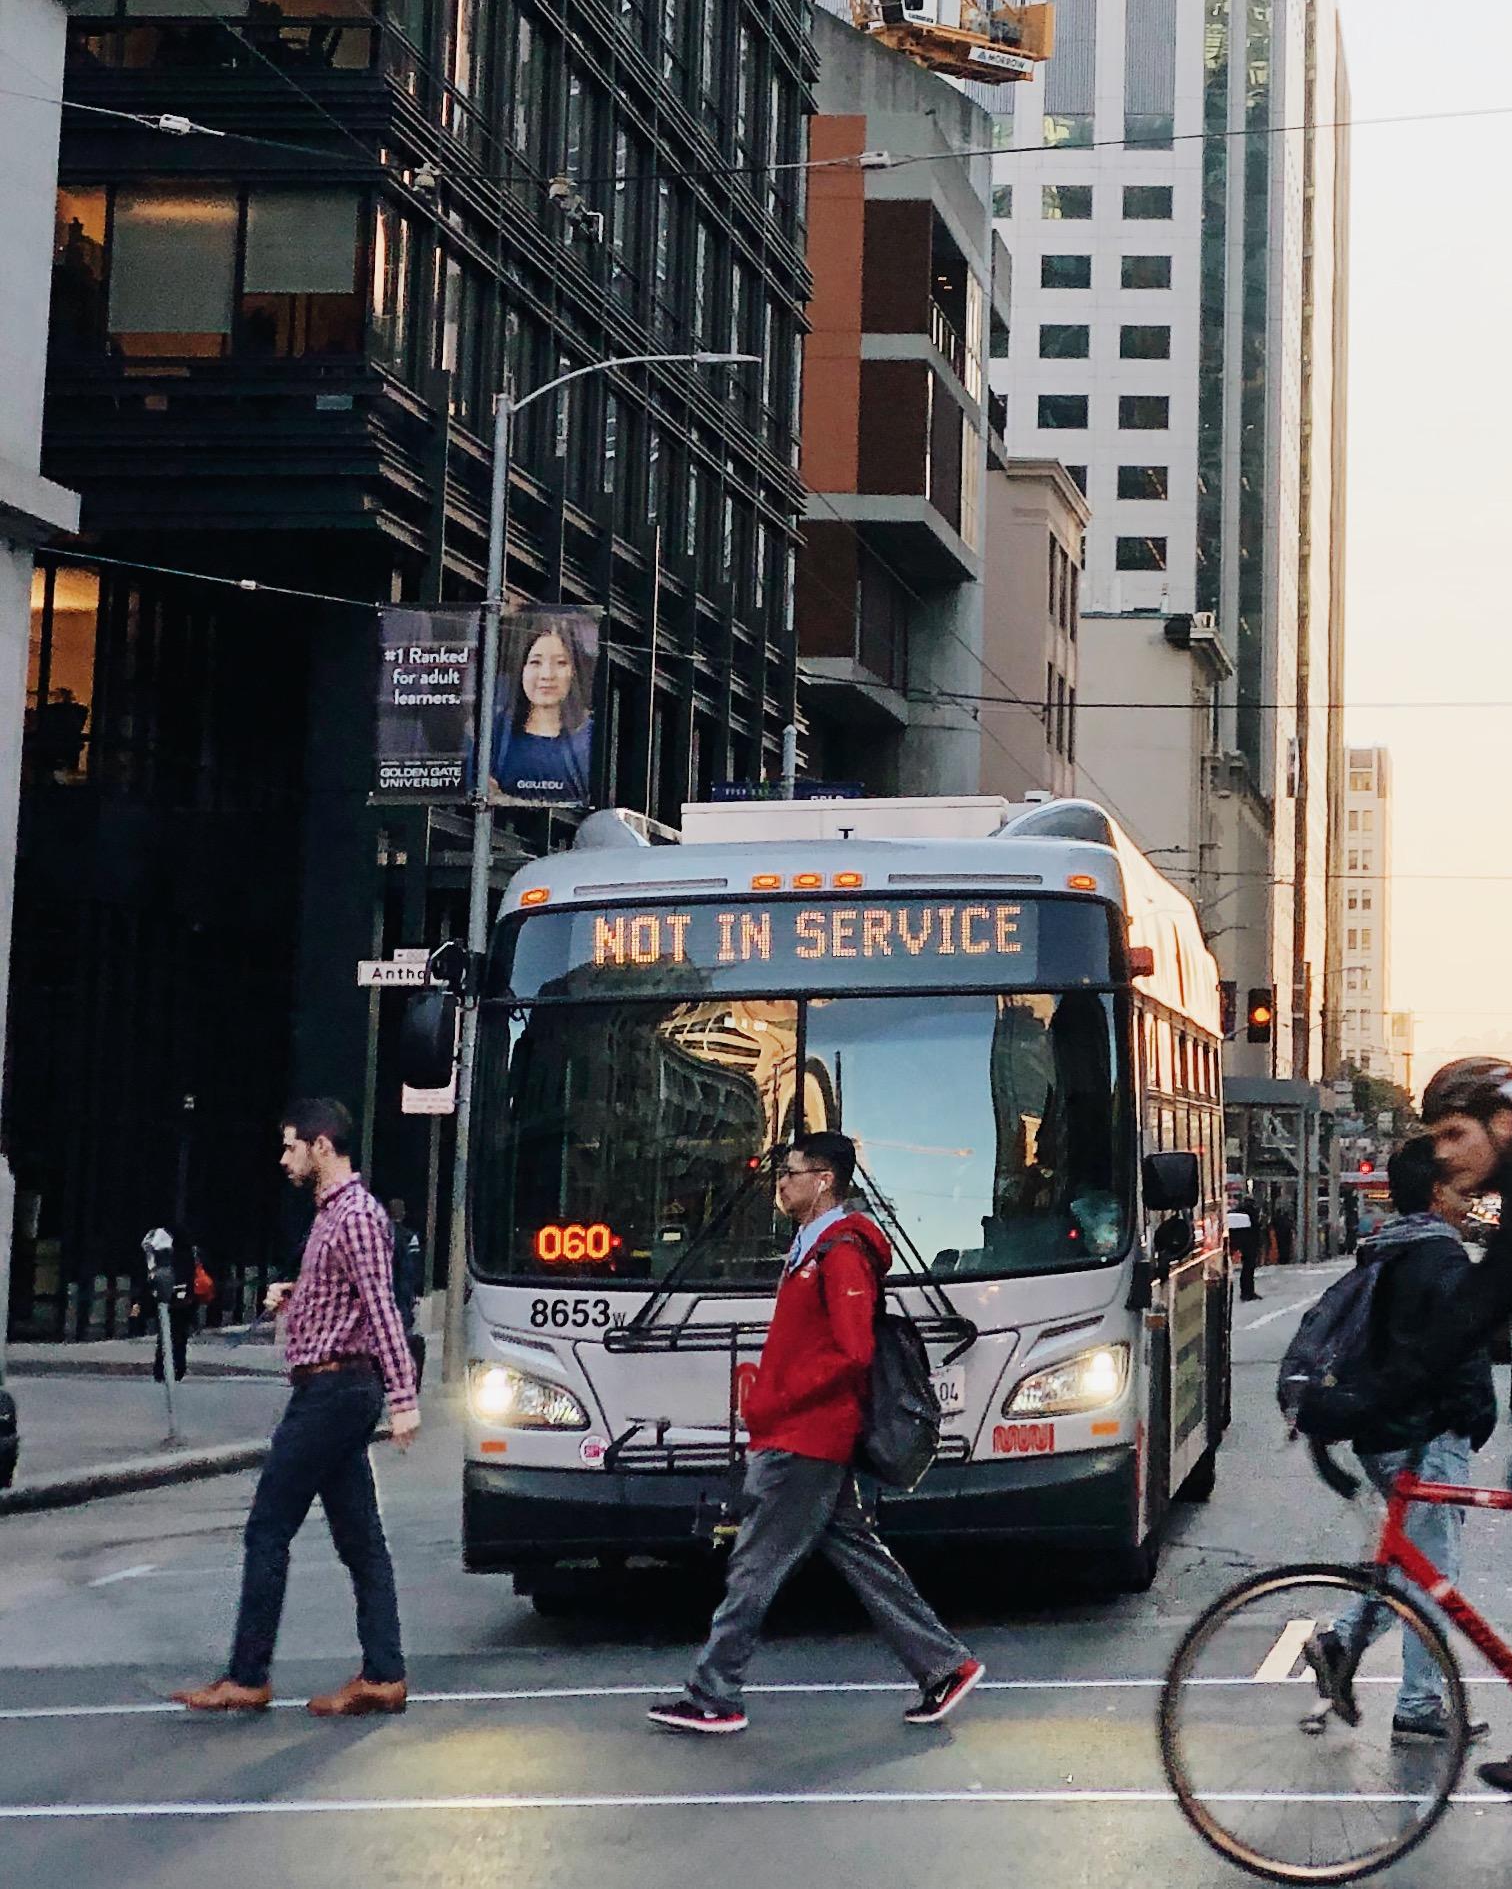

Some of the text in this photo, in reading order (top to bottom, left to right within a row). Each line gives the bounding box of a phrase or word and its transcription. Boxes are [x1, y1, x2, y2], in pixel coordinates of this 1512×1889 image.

[384, 648, 469, 664] #1 Ranked
[392, 669, 460, 684] for adult
[394, 690, 461, 705] learners.
[380, 767, 462, 778] GOLDEN GATE
[380, 777, 461, 788] UNIVERSITY
[594, 904, 1021, 965] NOT IN SERVICE
[371, 967, 427, 980] Antho
[537, 1223, 612, 1261] 060
[530, 1298, 611, 1328] 8653
